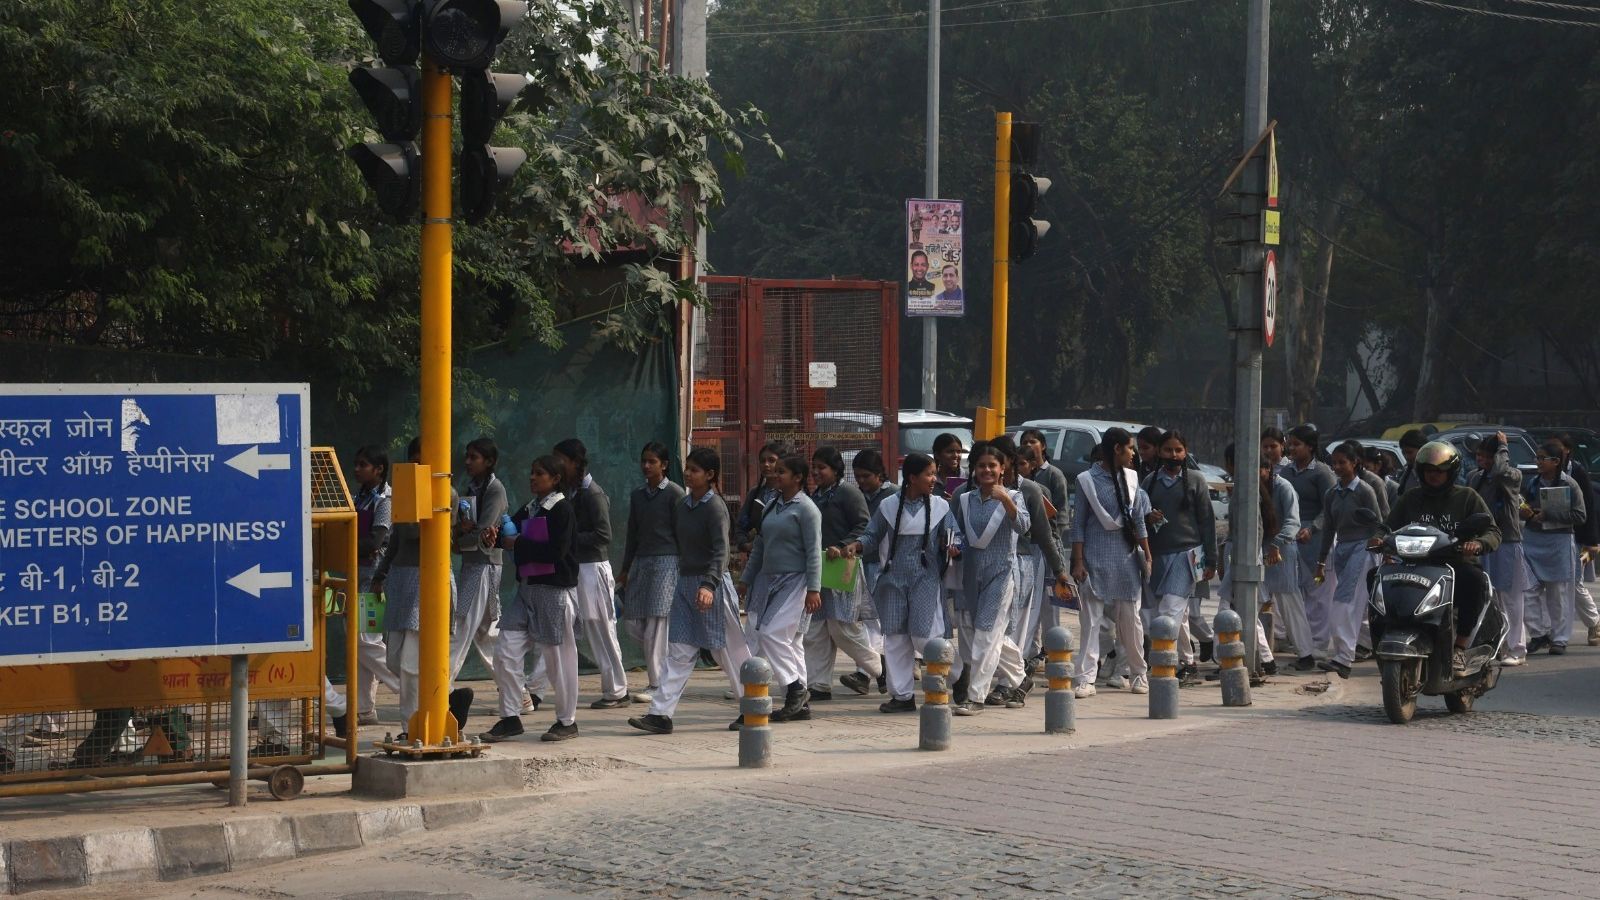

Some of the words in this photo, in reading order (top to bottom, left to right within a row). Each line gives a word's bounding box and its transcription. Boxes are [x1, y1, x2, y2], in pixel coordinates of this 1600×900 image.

[1266, 277, 1275, 319] 20
[0, 419, 52, 446] स्कूल
[64, 410, 113, 438] ज़ोन
[62, 451, 114, 475] ऑफ़
[14, 497, 119, 520] SCHOOL
[125, 495, 192, 517] ZONE
[0, 526, 98, 548] METERS
[105, 524, 139, 545] OF
[147, 520, 286, 544] HAPPINESS'
[91, 561, 140, 588] बी-2
[53, 603, 90, 626] B1,
[98, 602, 129, 622] B2
[268, 662, 295, 683] (N.)
